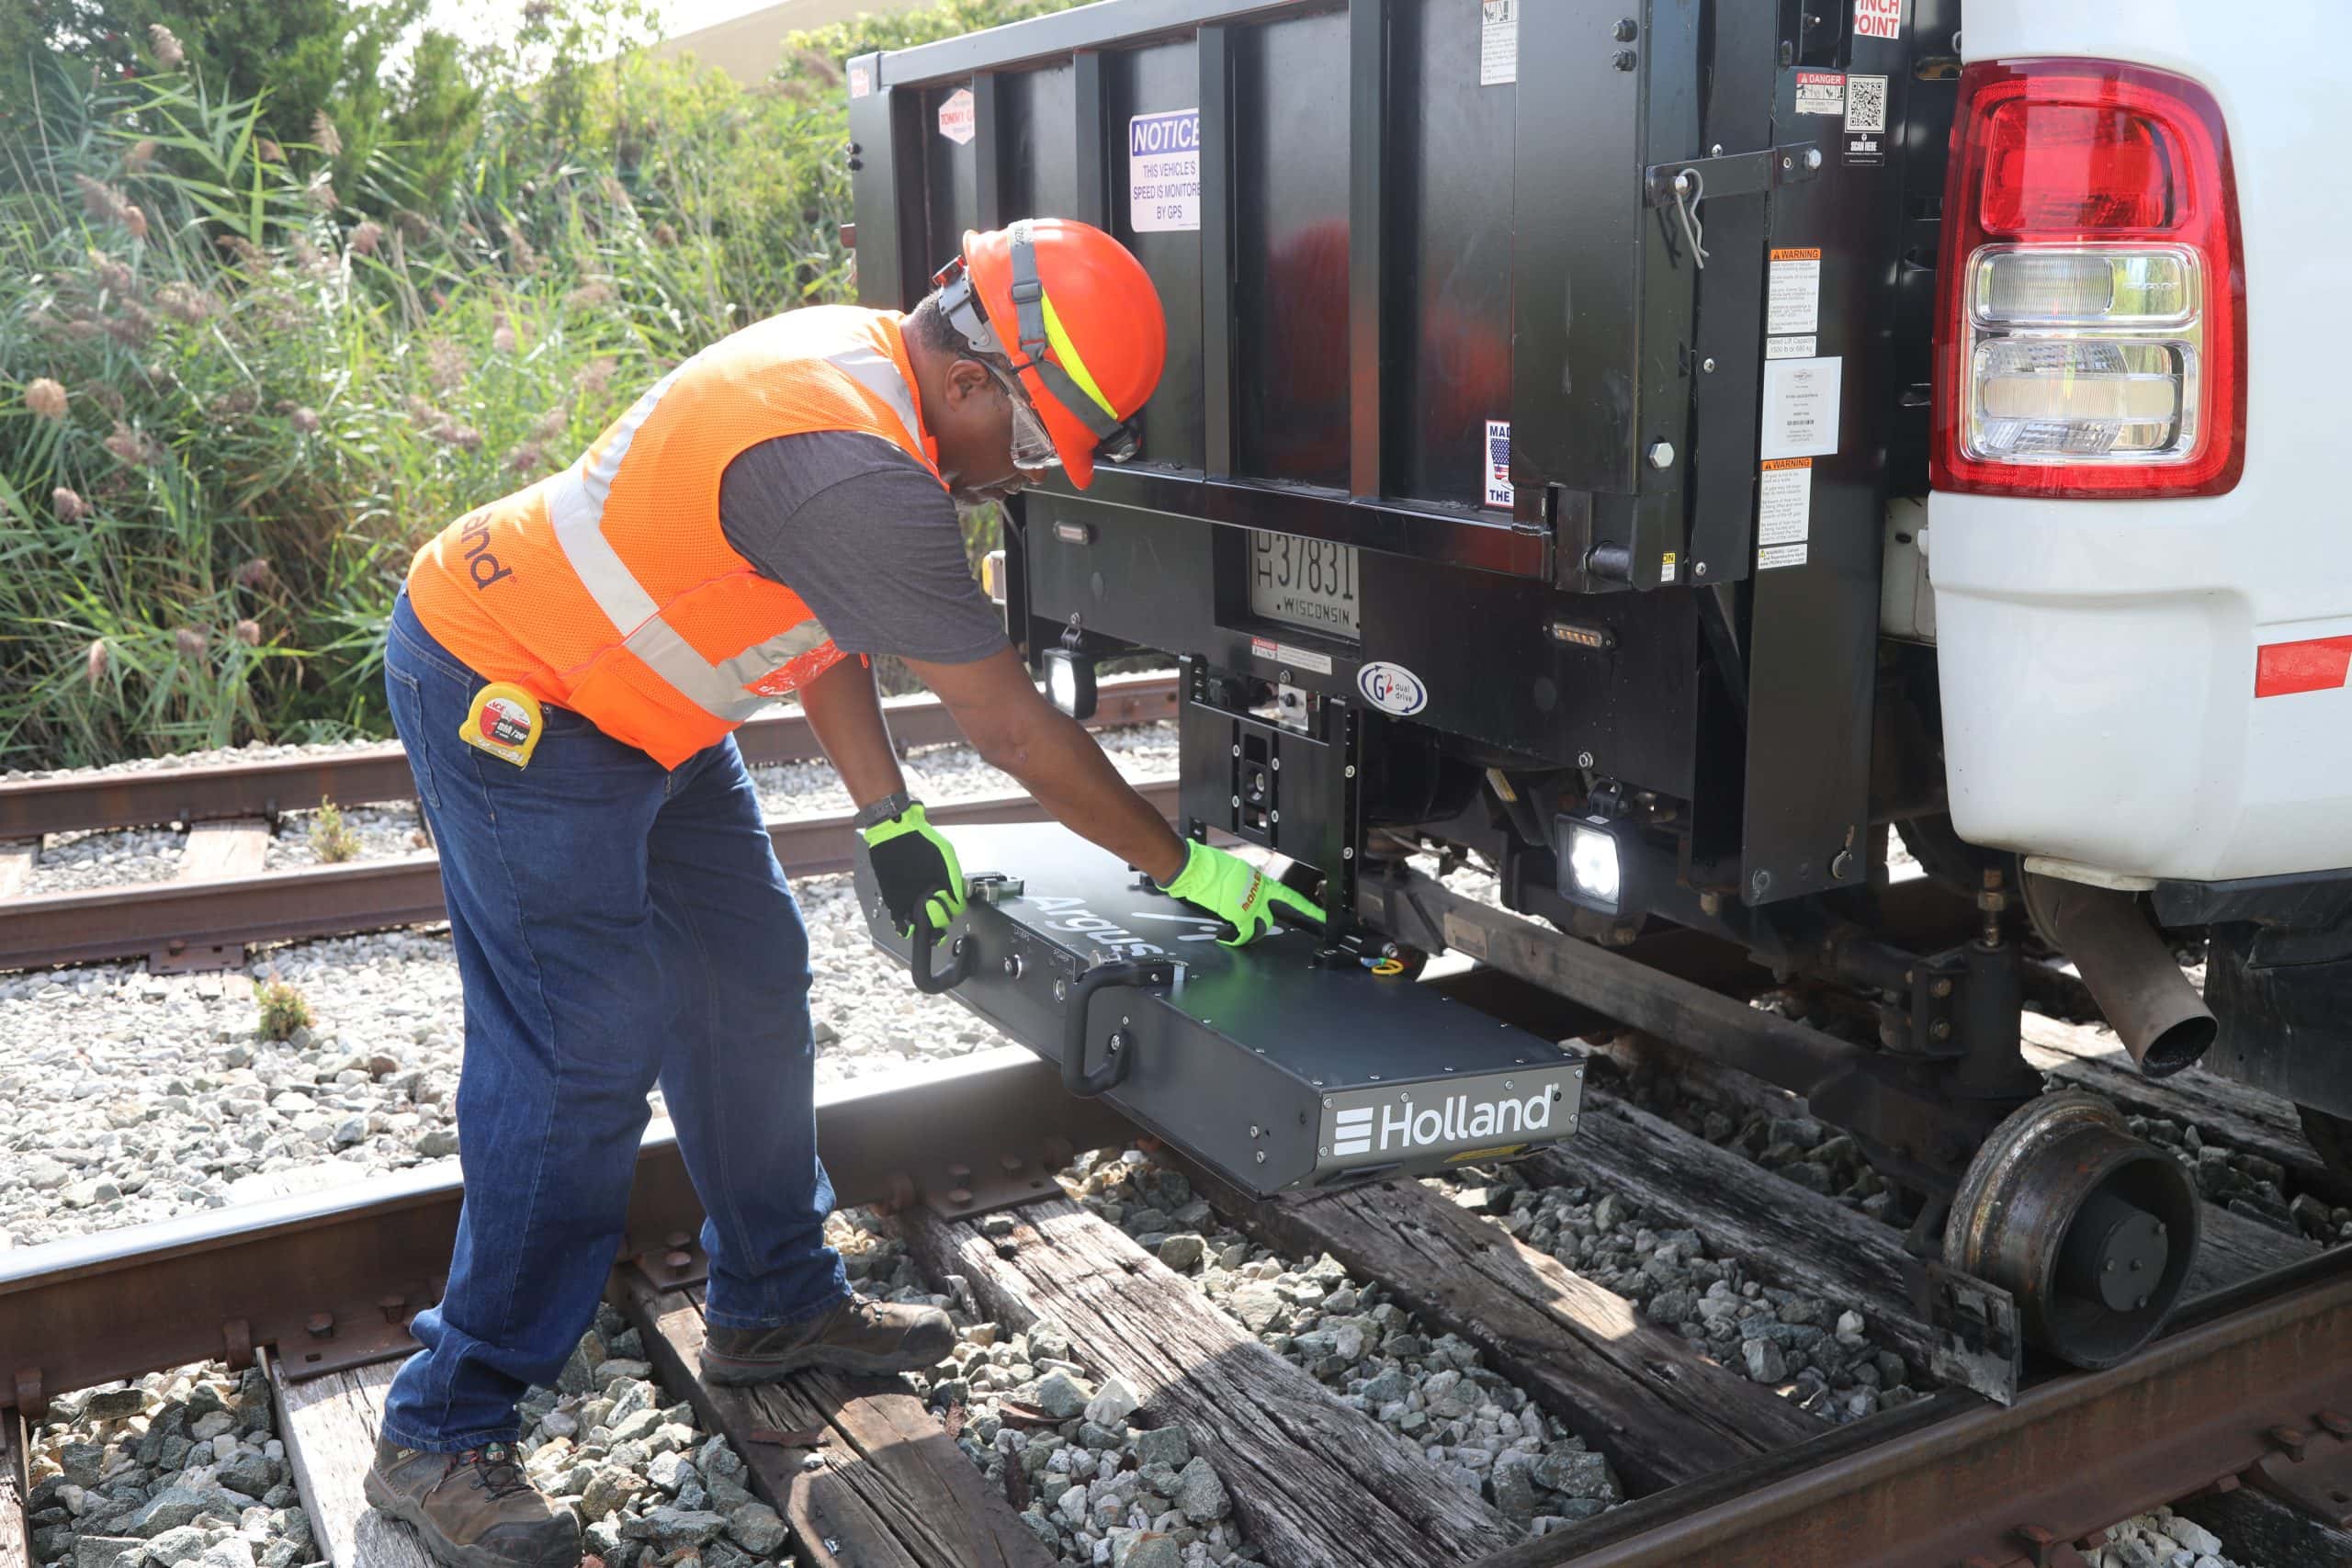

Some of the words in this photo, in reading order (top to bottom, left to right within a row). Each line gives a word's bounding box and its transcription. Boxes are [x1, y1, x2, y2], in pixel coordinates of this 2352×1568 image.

[1859, 0, 1899, 15] INCH
[1854, 14, 1898, 38] OINT
[1809, 74, 1842, 85] DANGER
[1134, 117, 1200, 152] NOTICE
[1143, 164, 1159, 178] THIS
[1159, 161, 1196, 177] VEHICLE'S
[1133, 185, 1156, 200] SPEED
[1157, 184, 1164, 198] IS
[1165, 182, 1201, 197] MONITORE
[1157, 206, 1166, 220] BY
[1167, 205, 1182, 220] GPS
[1781, 249, 1819, 258] WARNING
[1774, 458, 1810, 468] WARNING
[1489, 490, 1510, 502] THE
[1276, 534, 1353, 601] 37831
[1283, 597, 1350, 626] WISCONSIN
[1396, 683, 1409, 693] dual
[1396, 692, 1412, 703] drive
[1014, 896, 1164, 957] Argus
[1380, 1083, 1553, 1151] Holland
